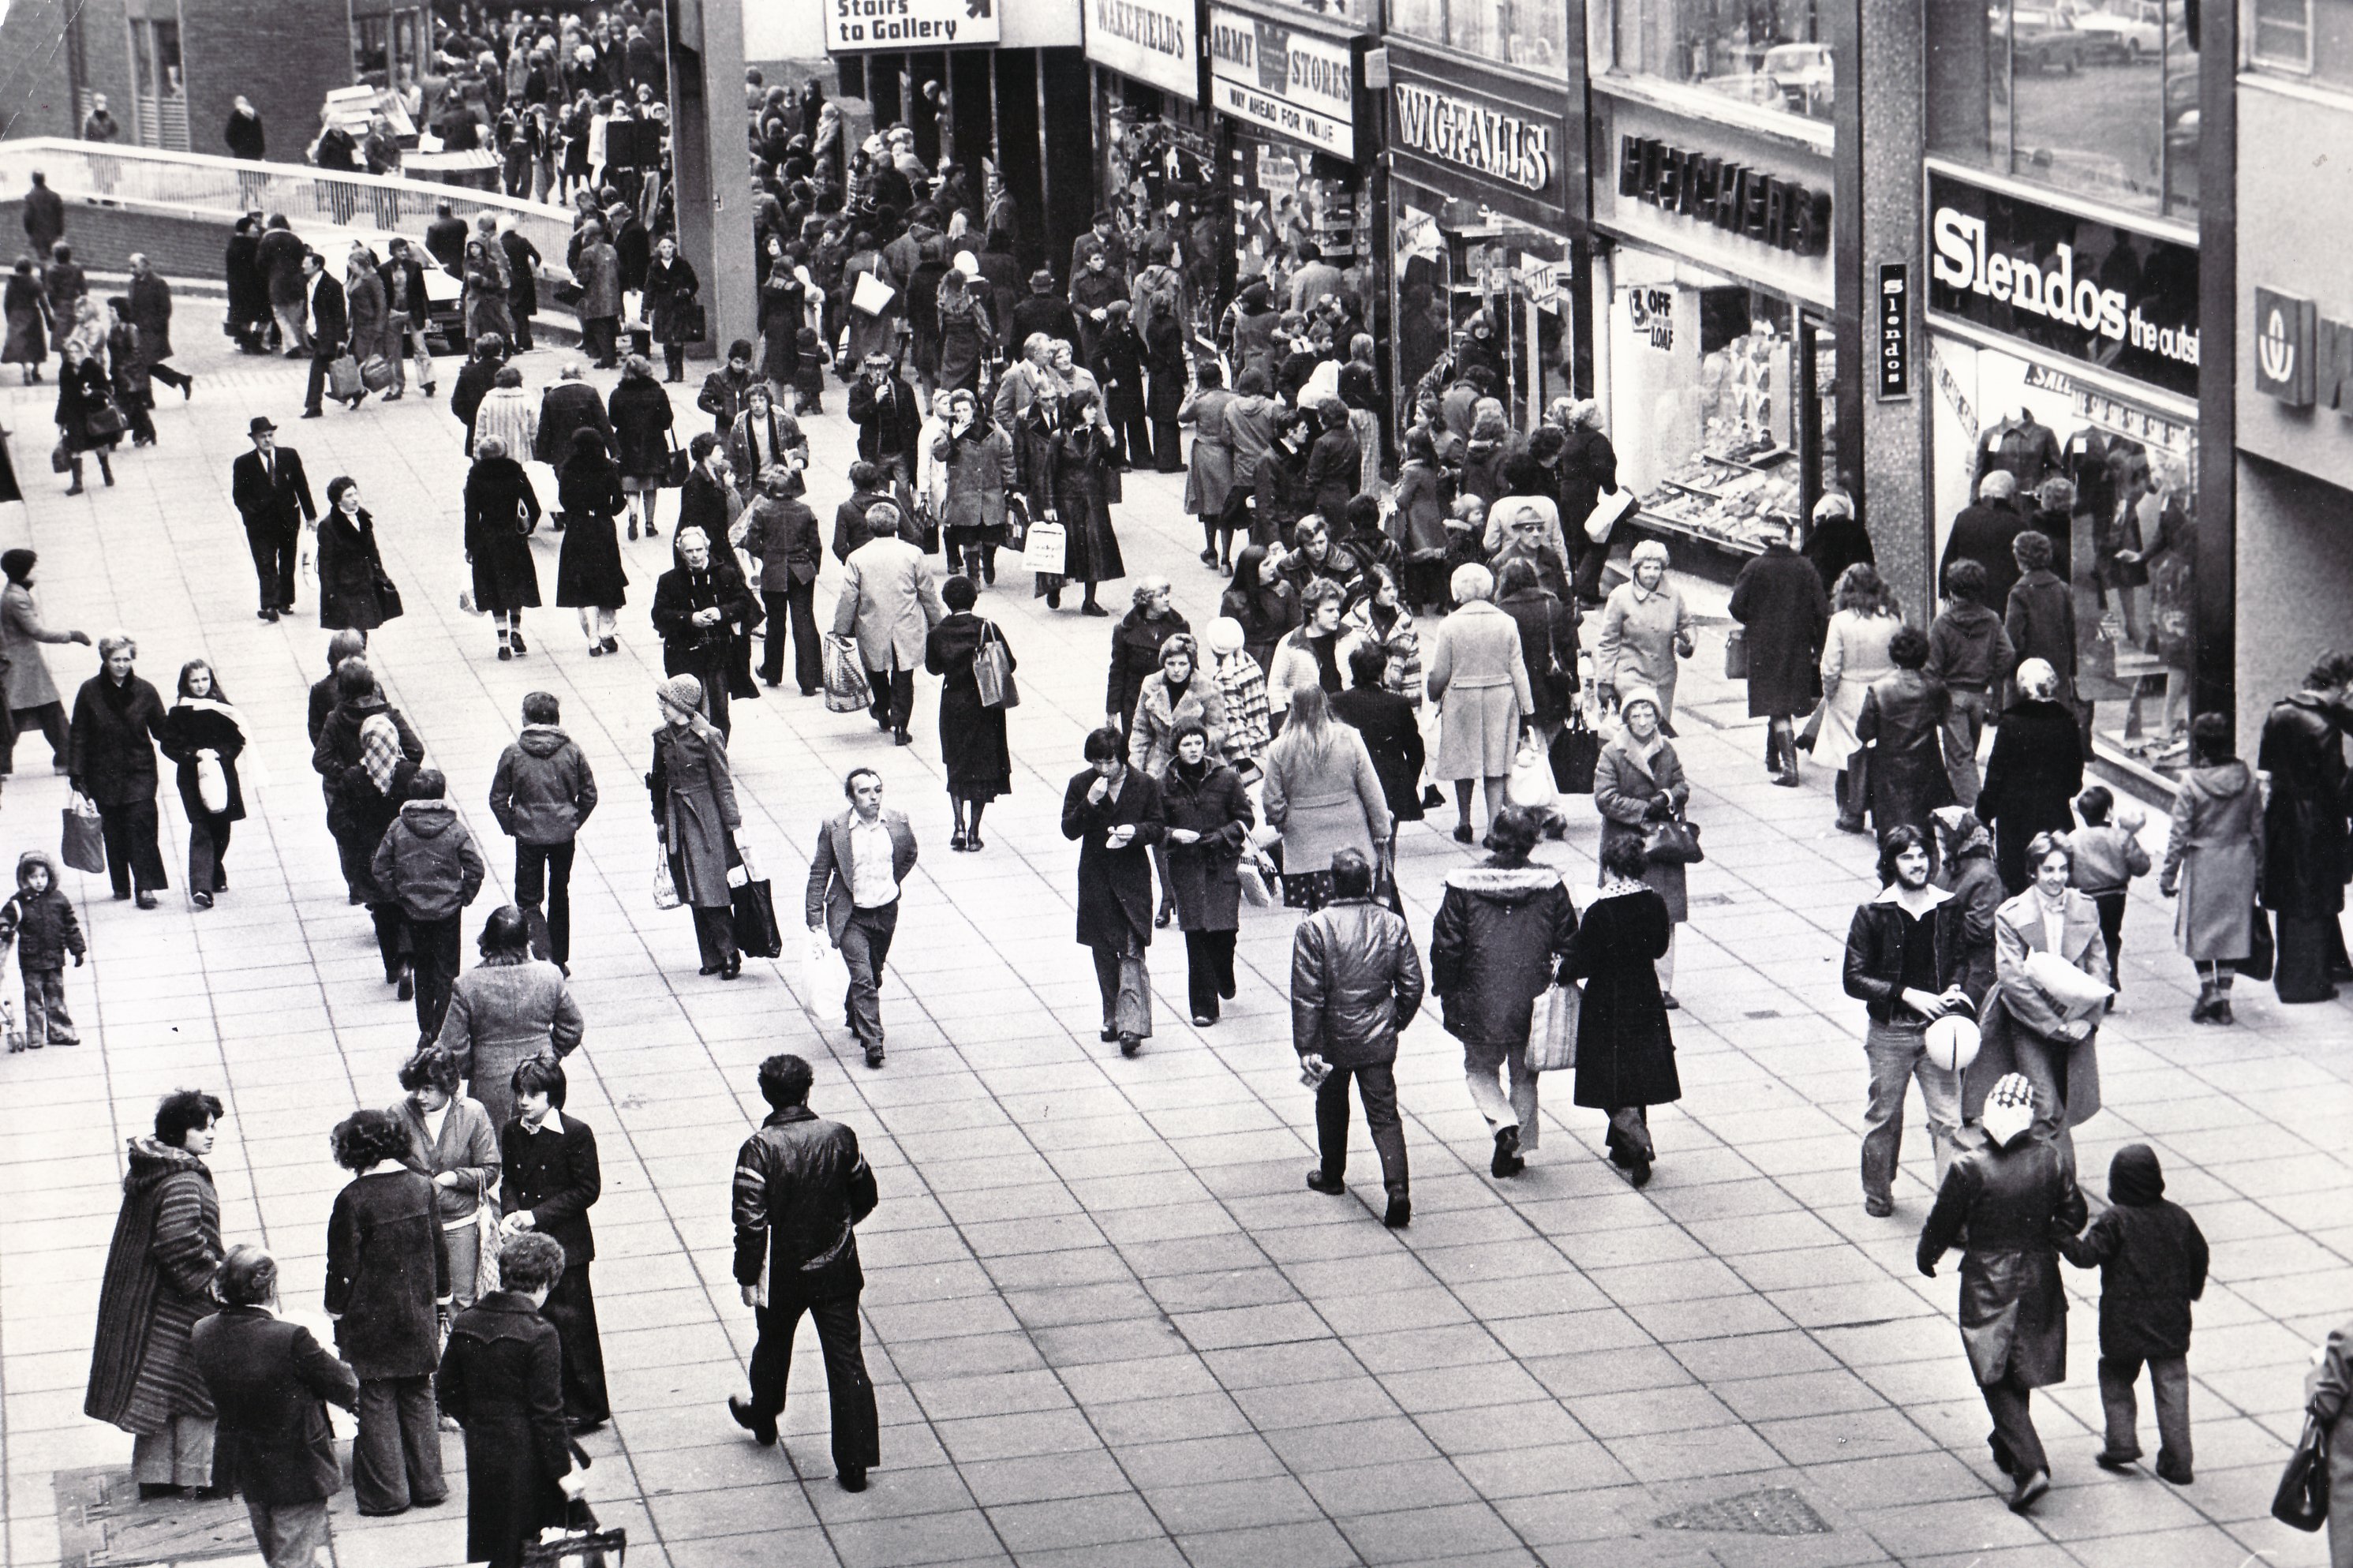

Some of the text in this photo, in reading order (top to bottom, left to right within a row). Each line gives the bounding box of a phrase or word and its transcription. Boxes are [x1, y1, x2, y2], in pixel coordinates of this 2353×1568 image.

[838, 0, 908, 17] Stairs
[840, 17, 956, 41] to Gallery
[1096, 0, 1184, 60] WAKEFIELDS
[1213, 24, 1253, 67] ARMY
[1292, 50, 1351, 102] STORES
[1229, 88, 1334, 143] WAY AHEAD FOR VALUE
[1395, 83, 1547, 190] WIGFALLS
[1648, 289, 1671, 317] OFF
[1934, 207, 2127, 341] Slendos
[2129, 305, 2157, 352] the
[1651, 325, 1674, 351] LOAF
